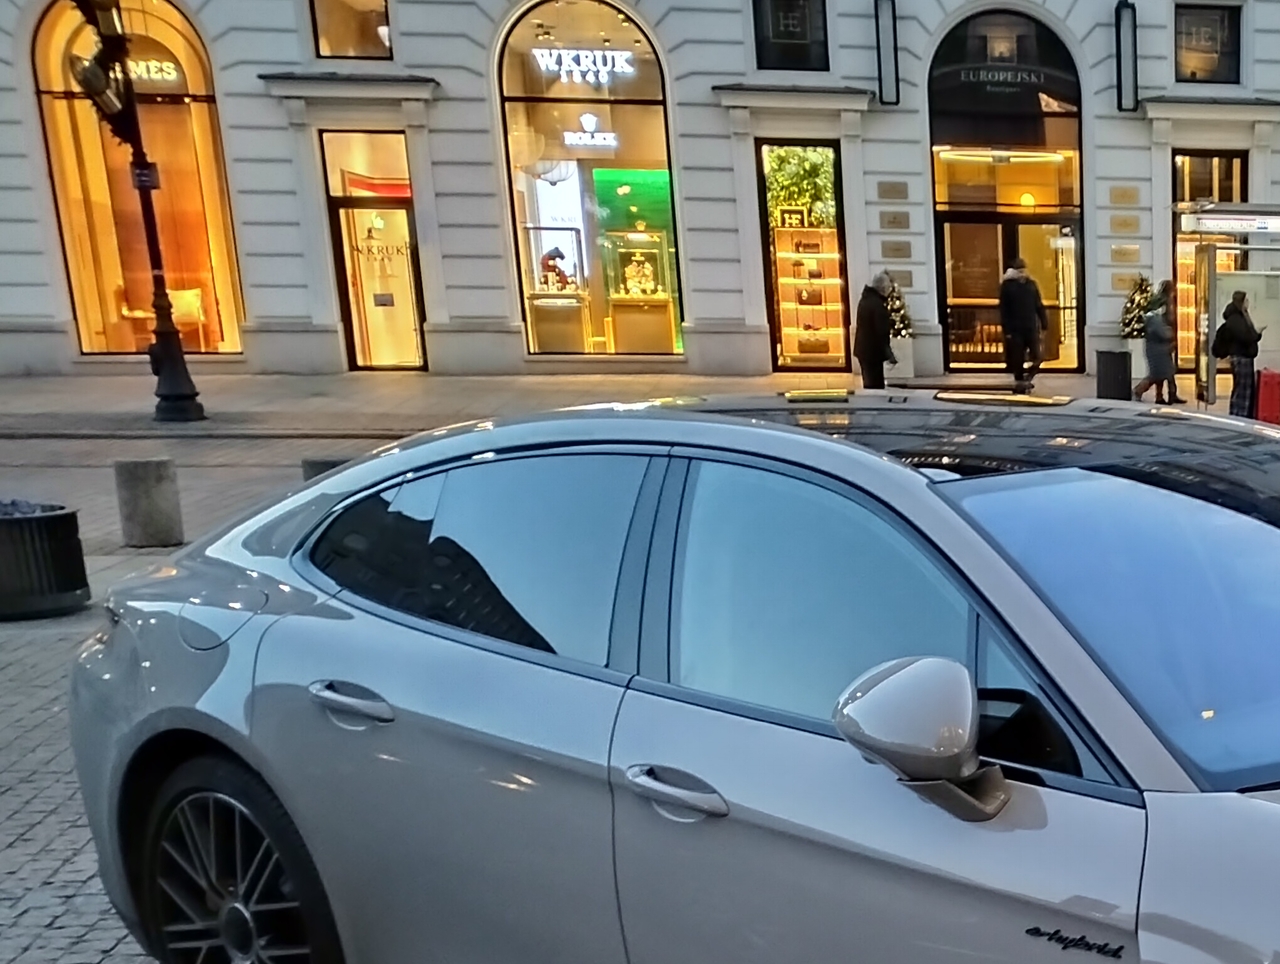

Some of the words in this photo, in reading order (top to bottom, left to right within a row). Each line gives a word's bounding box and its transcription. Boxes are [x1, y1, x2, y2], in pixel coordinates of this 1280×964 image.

[560, 69, 609, 83] 1840
[961, 69, 1045, 83] EUROPEJSKI
[1025, 927, 1125, 959] e-hybrid
